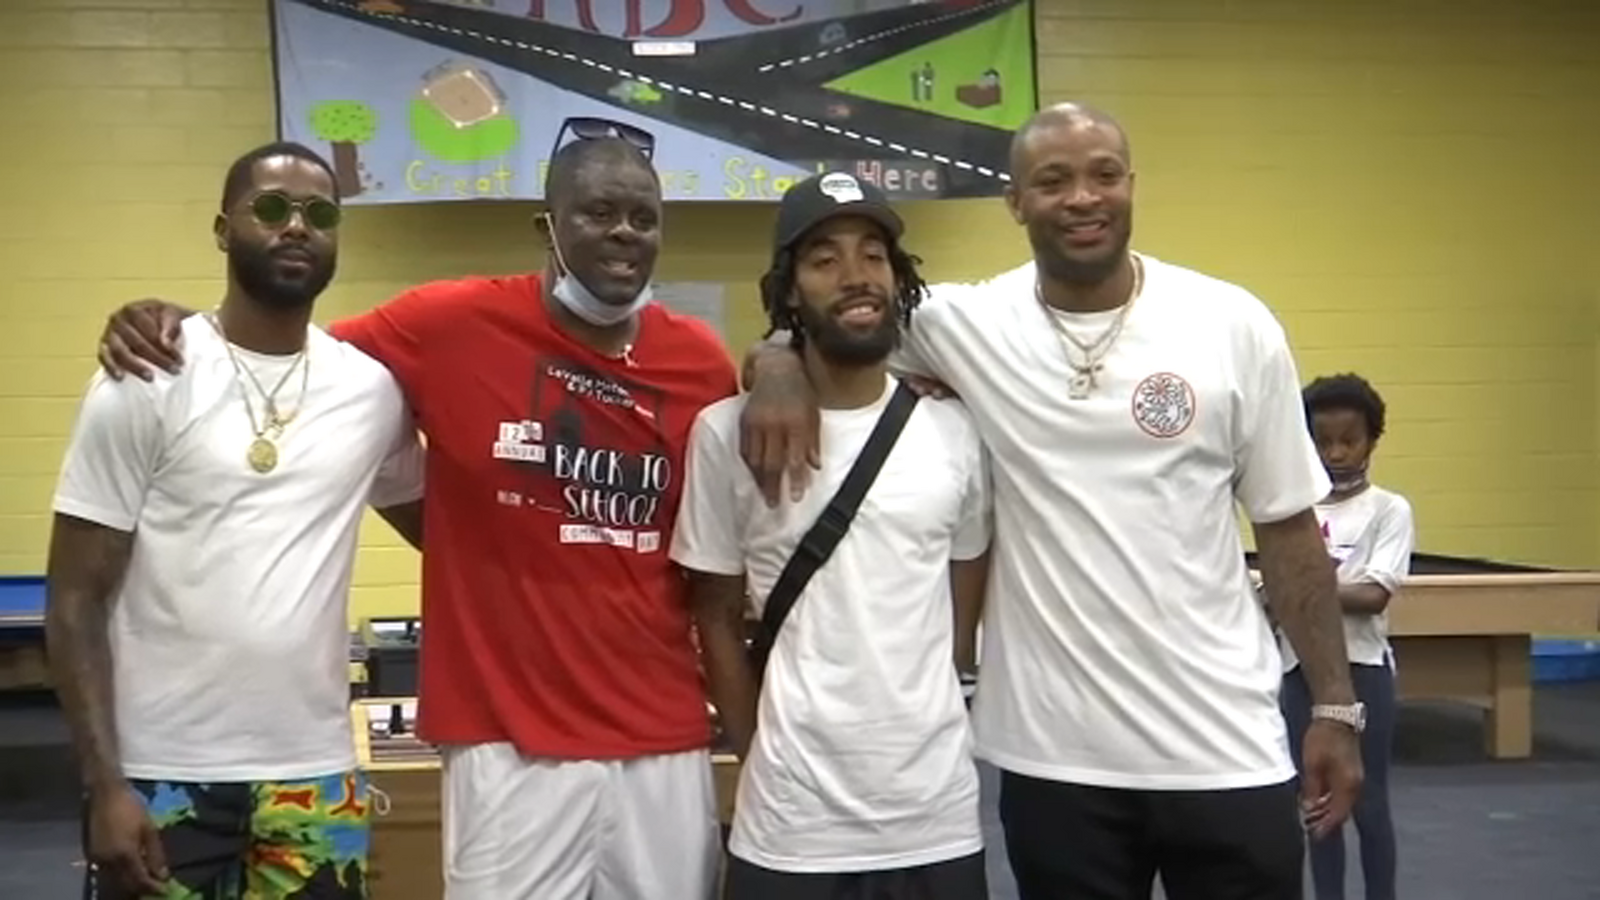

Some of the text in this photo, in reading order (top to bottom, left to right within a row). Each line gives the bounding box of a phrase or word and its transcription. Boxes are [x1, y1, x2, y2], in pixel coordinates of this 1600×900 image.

[405, 159, 513, 197] Great
[856, 160, 938, 192] Here
[555, 445, 671, 491] BACK TO
[564, 484, 658, 525] SCHOOL
